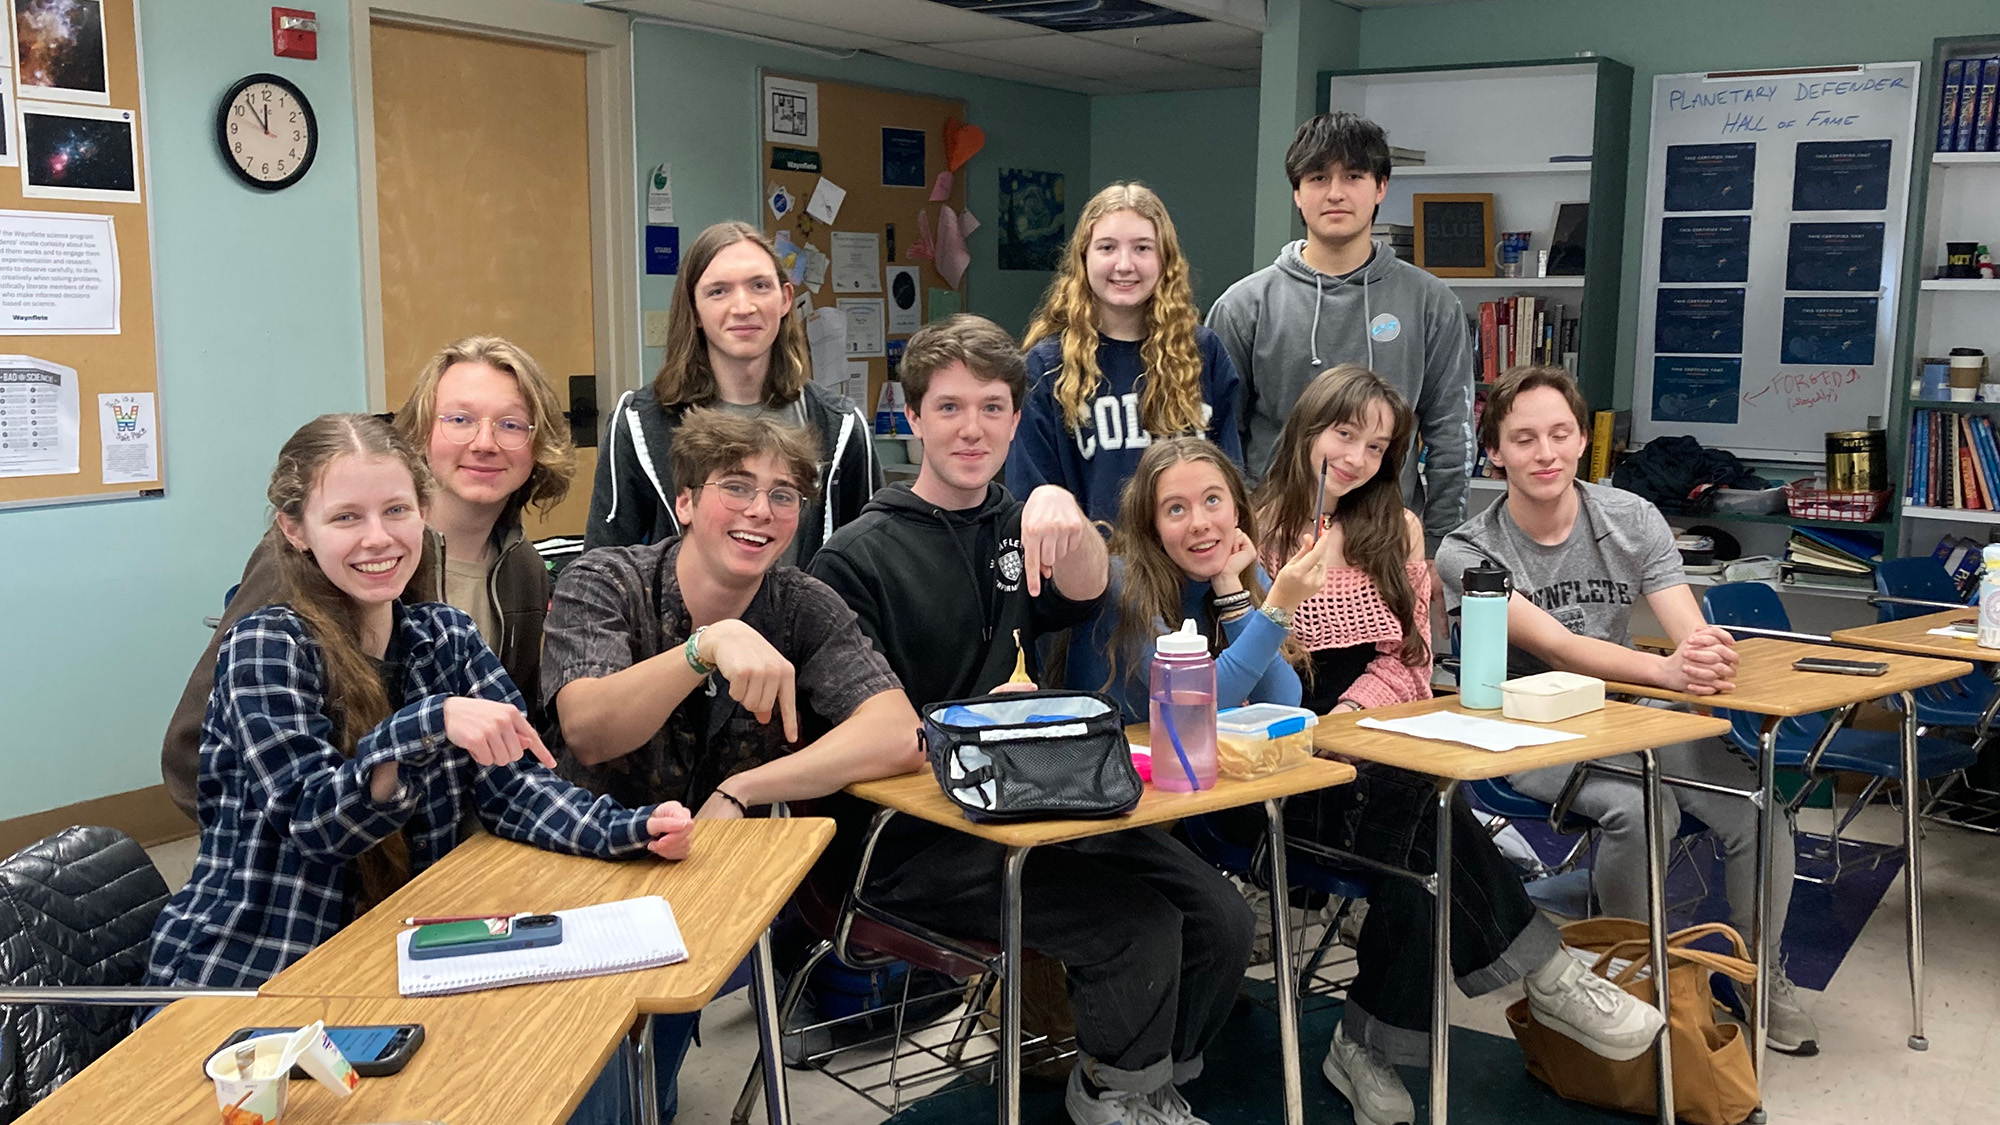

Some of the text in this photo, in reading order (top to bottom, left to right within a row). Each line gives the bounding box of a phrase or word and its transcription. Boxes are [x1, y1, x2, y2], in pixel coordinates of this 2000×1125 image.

[261, 90, 272, 102] 12
[1669, 78, 1910, 111] PLANETARY DEFENDER
[279, 98, 284, 108] 1
[233, 105, 245, 117] 10
[289, 111, 297, 123] 2
[1721, 112, 1767, 134] HALL
[1806, 110, 1860, 126] FAME
[230, 122, 238, 135] 9
[293, 130, 300, 141] 3
[234, 142, 242, 154] 8
[288, 148, 296, 158] 4
[246, 156, 254, 168] 7
[277, 159, 285, 171] 5
[261, 163, 269, 174] 6
[1427, 223, 1481, 238] BLUE
[1949, 254, 1971, 266] MIT
[3, 373, 18, 382] BAD
[1770, 370, 1843, 394] FORGED
[1074, 392, 1213, 461] COL
[1527, 579, 1632, 610] YNFLETE
